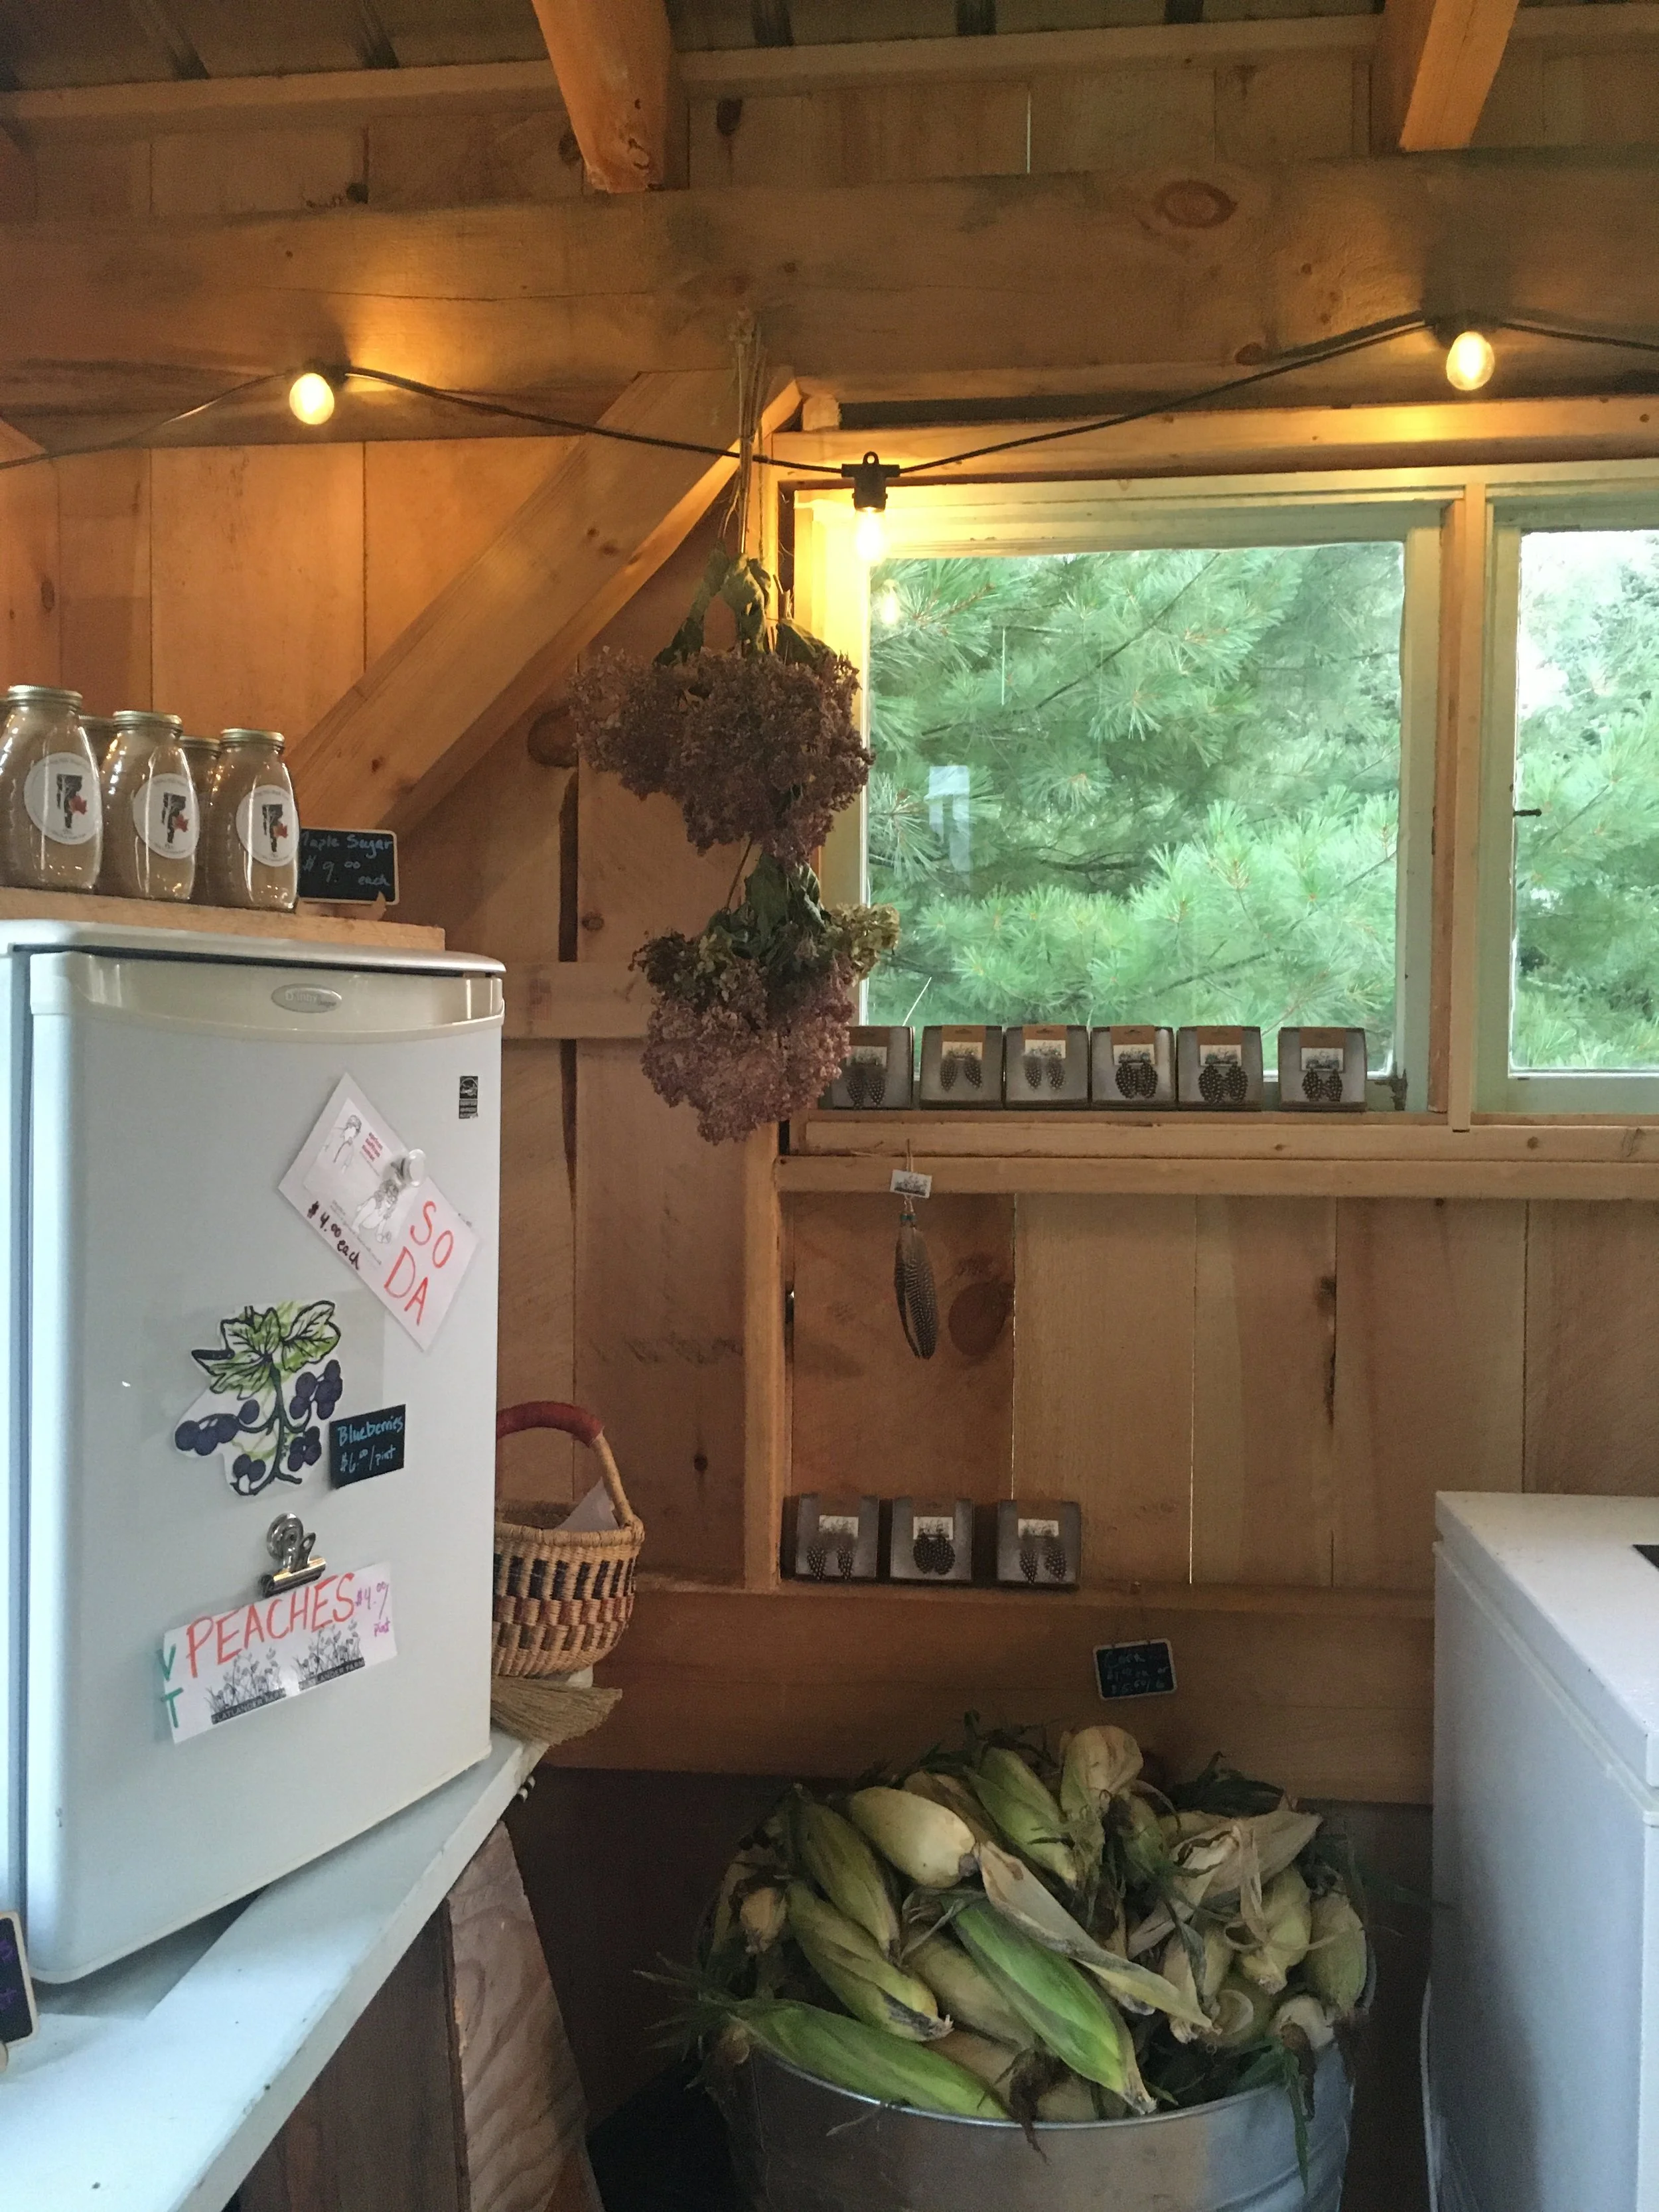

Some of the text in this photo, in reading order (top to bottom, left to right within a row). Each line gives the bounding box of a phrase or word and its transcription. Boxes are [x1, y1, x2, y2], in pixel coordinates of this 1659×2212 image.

[347, 834, 394, 859] Sugar
[358, 874, 391, 886] each
[337, 1240, 360, 1270] each
[337, 1416, 403, 1446] Blueberries
[186, 1572, 354, 1678] PEACHES
